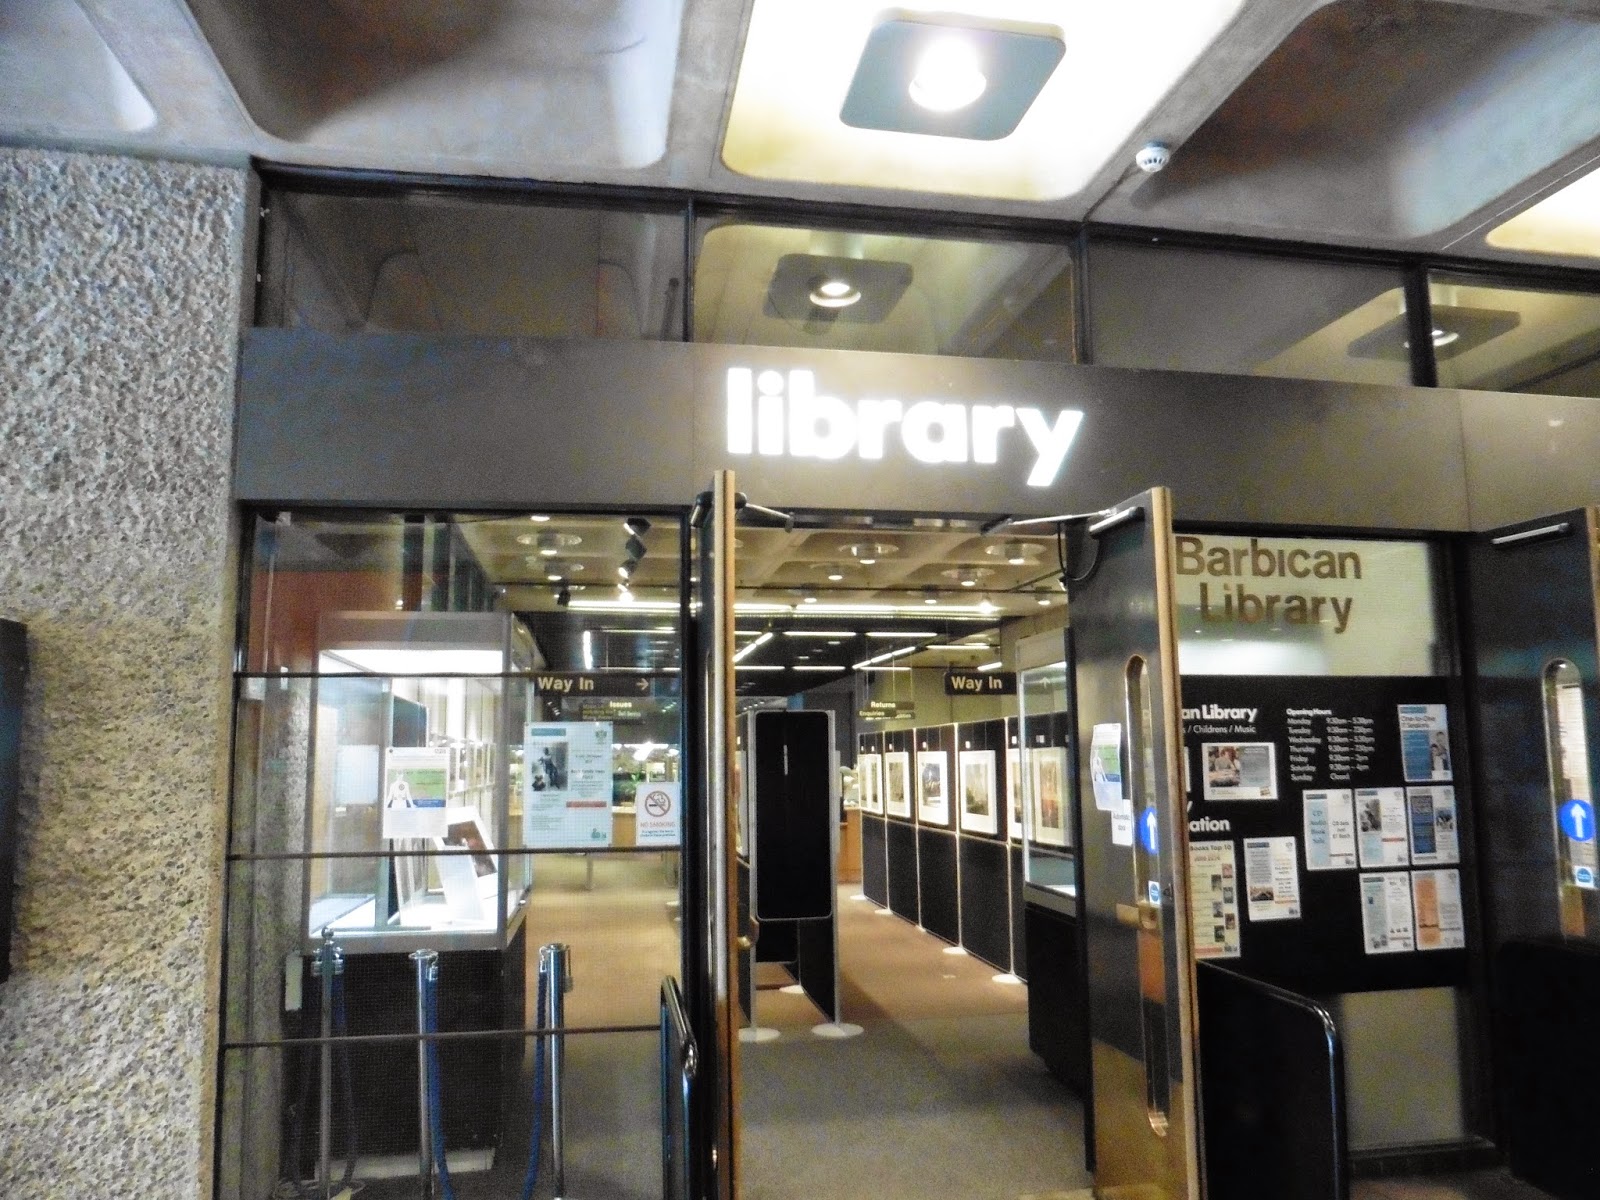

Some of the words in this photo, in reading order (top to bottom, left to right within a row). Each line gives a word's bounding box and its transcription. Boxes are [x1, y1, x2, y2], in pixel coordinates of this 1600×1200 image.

[727, 367, 1084, 487] library
[1175, 536, 1362, 579] Barbican
[1200, 582, 1353, 634] Library
[538, 677, 573, 692] Way
[580, 677, 594, 690] In
[951, 676, 982, 691] Way
[988, 676, 1002, 689] In
[1201, 703, 1258, 723] Library
[1286, 708, 1313, 717] Opening
[1193, 725, 1228, 734] Childrens
[1234, 725, 1257, 734] Music
